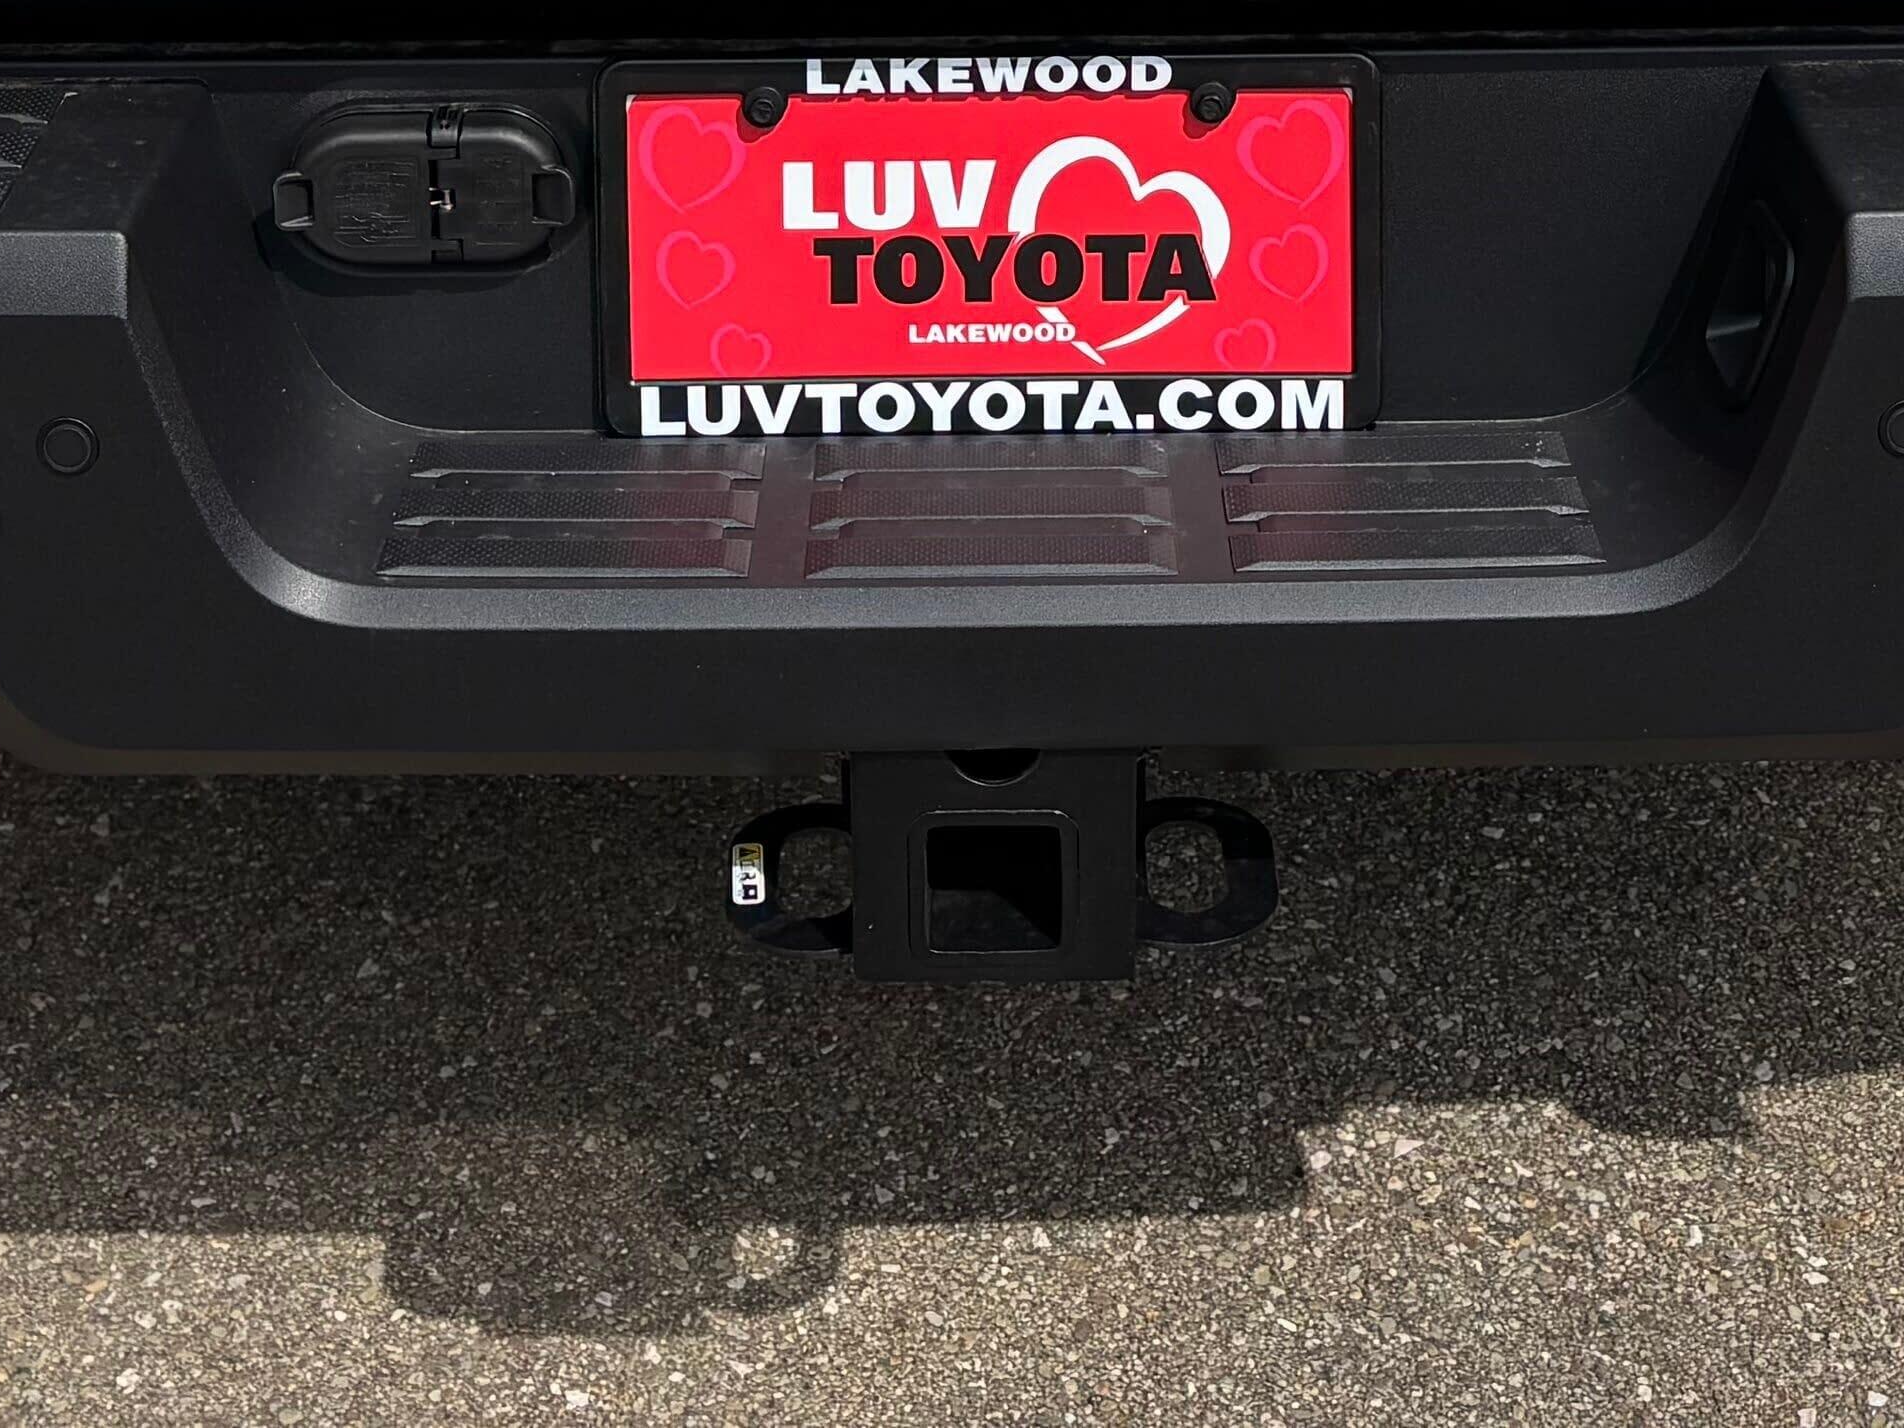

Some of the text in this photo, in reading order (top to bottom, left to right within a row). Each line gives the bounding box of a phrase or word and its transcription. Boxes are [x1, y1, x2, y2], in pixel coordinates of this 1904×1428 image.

[806, 55, 1173, 95] LAKEWOOD
[781, 158, 996, 231] LUV
[813, 233, 1217, 305] TOYOTA
[908, 321, 1076, 345] LAKEWOOD
[639, 378, 1345, 437] LUVTOYOTA.COM
